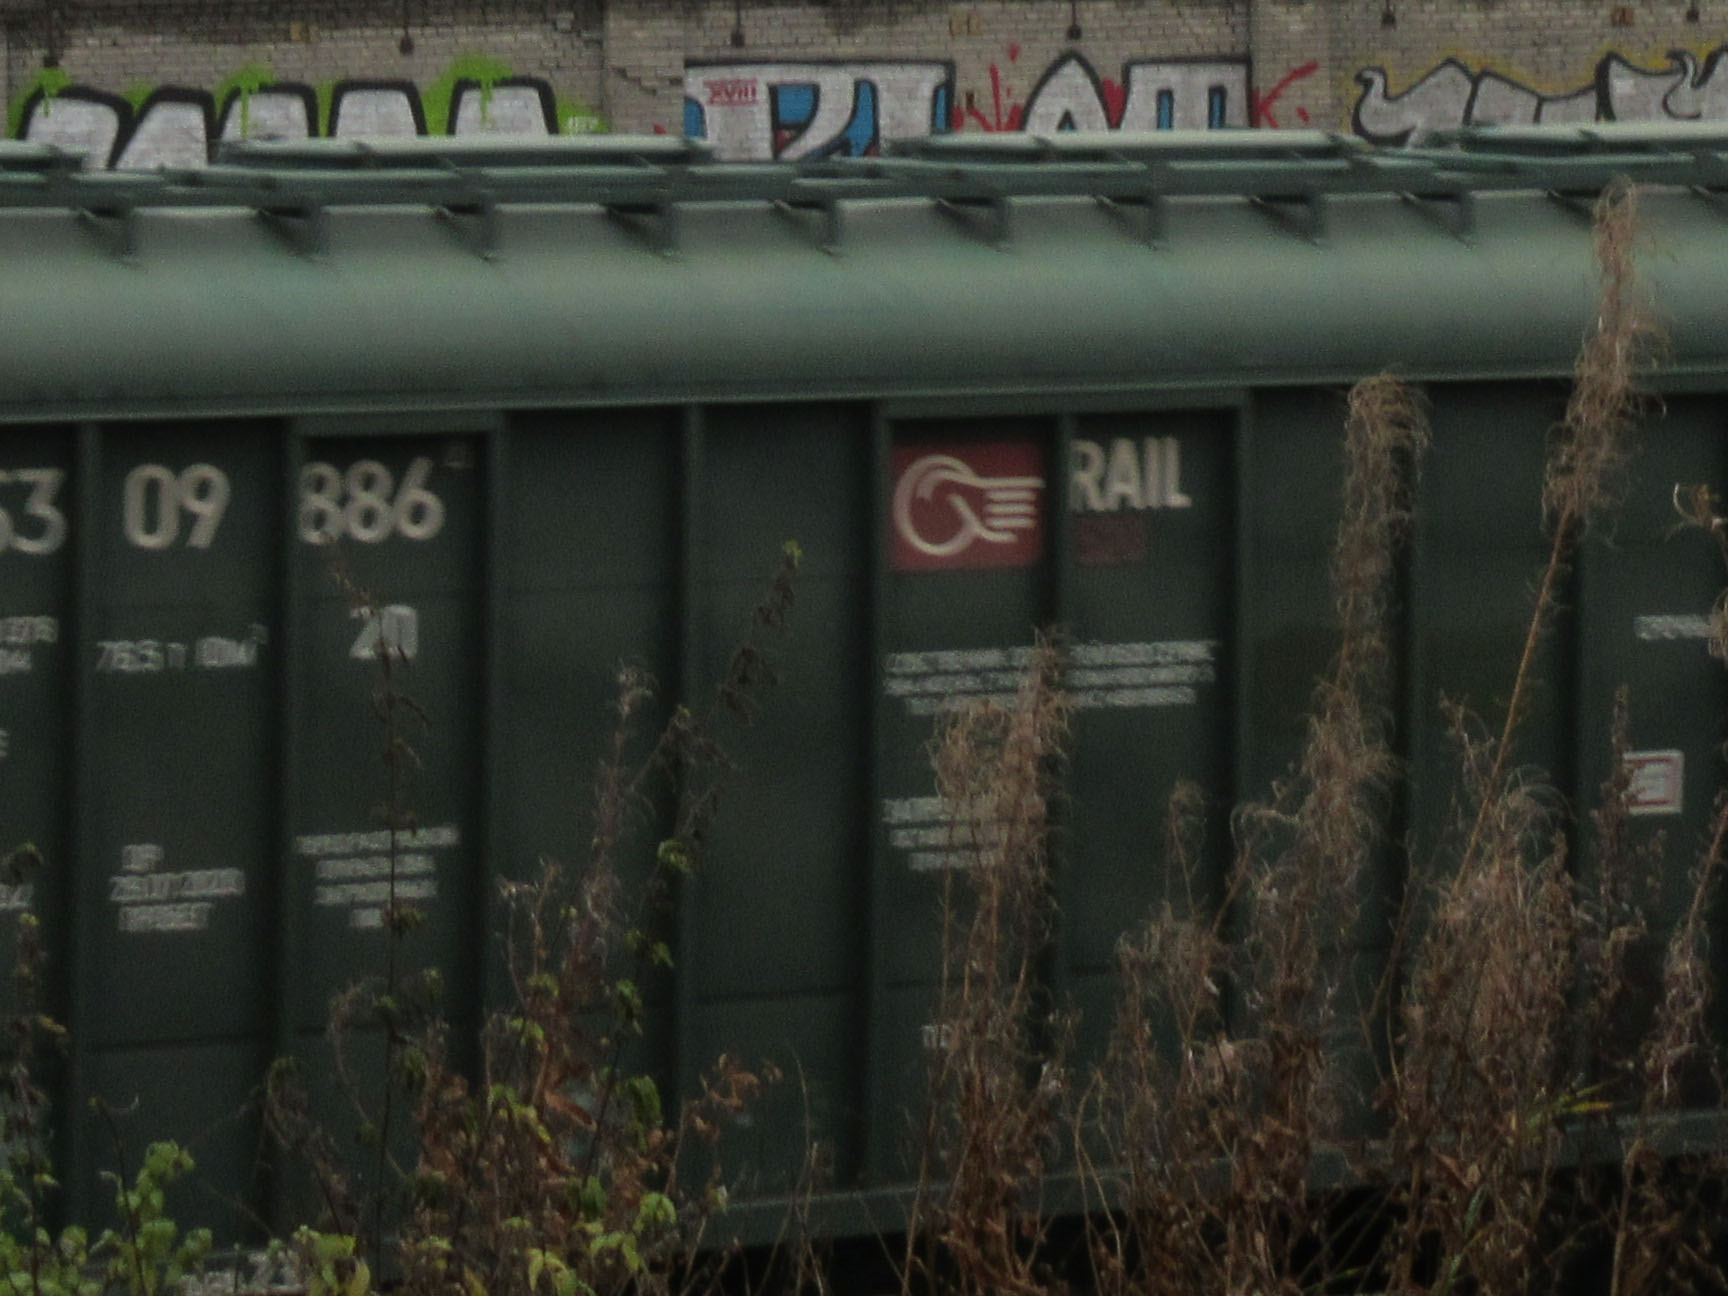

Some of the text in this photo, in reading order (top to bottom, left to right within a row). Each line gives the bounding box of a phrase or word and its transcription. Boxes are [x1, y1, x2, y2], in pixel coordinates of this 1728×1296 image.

[122, 463, 231, 551] 09
[297, 456, 445, 545] 886
[1073, 434, 1193, 513] RAIL
